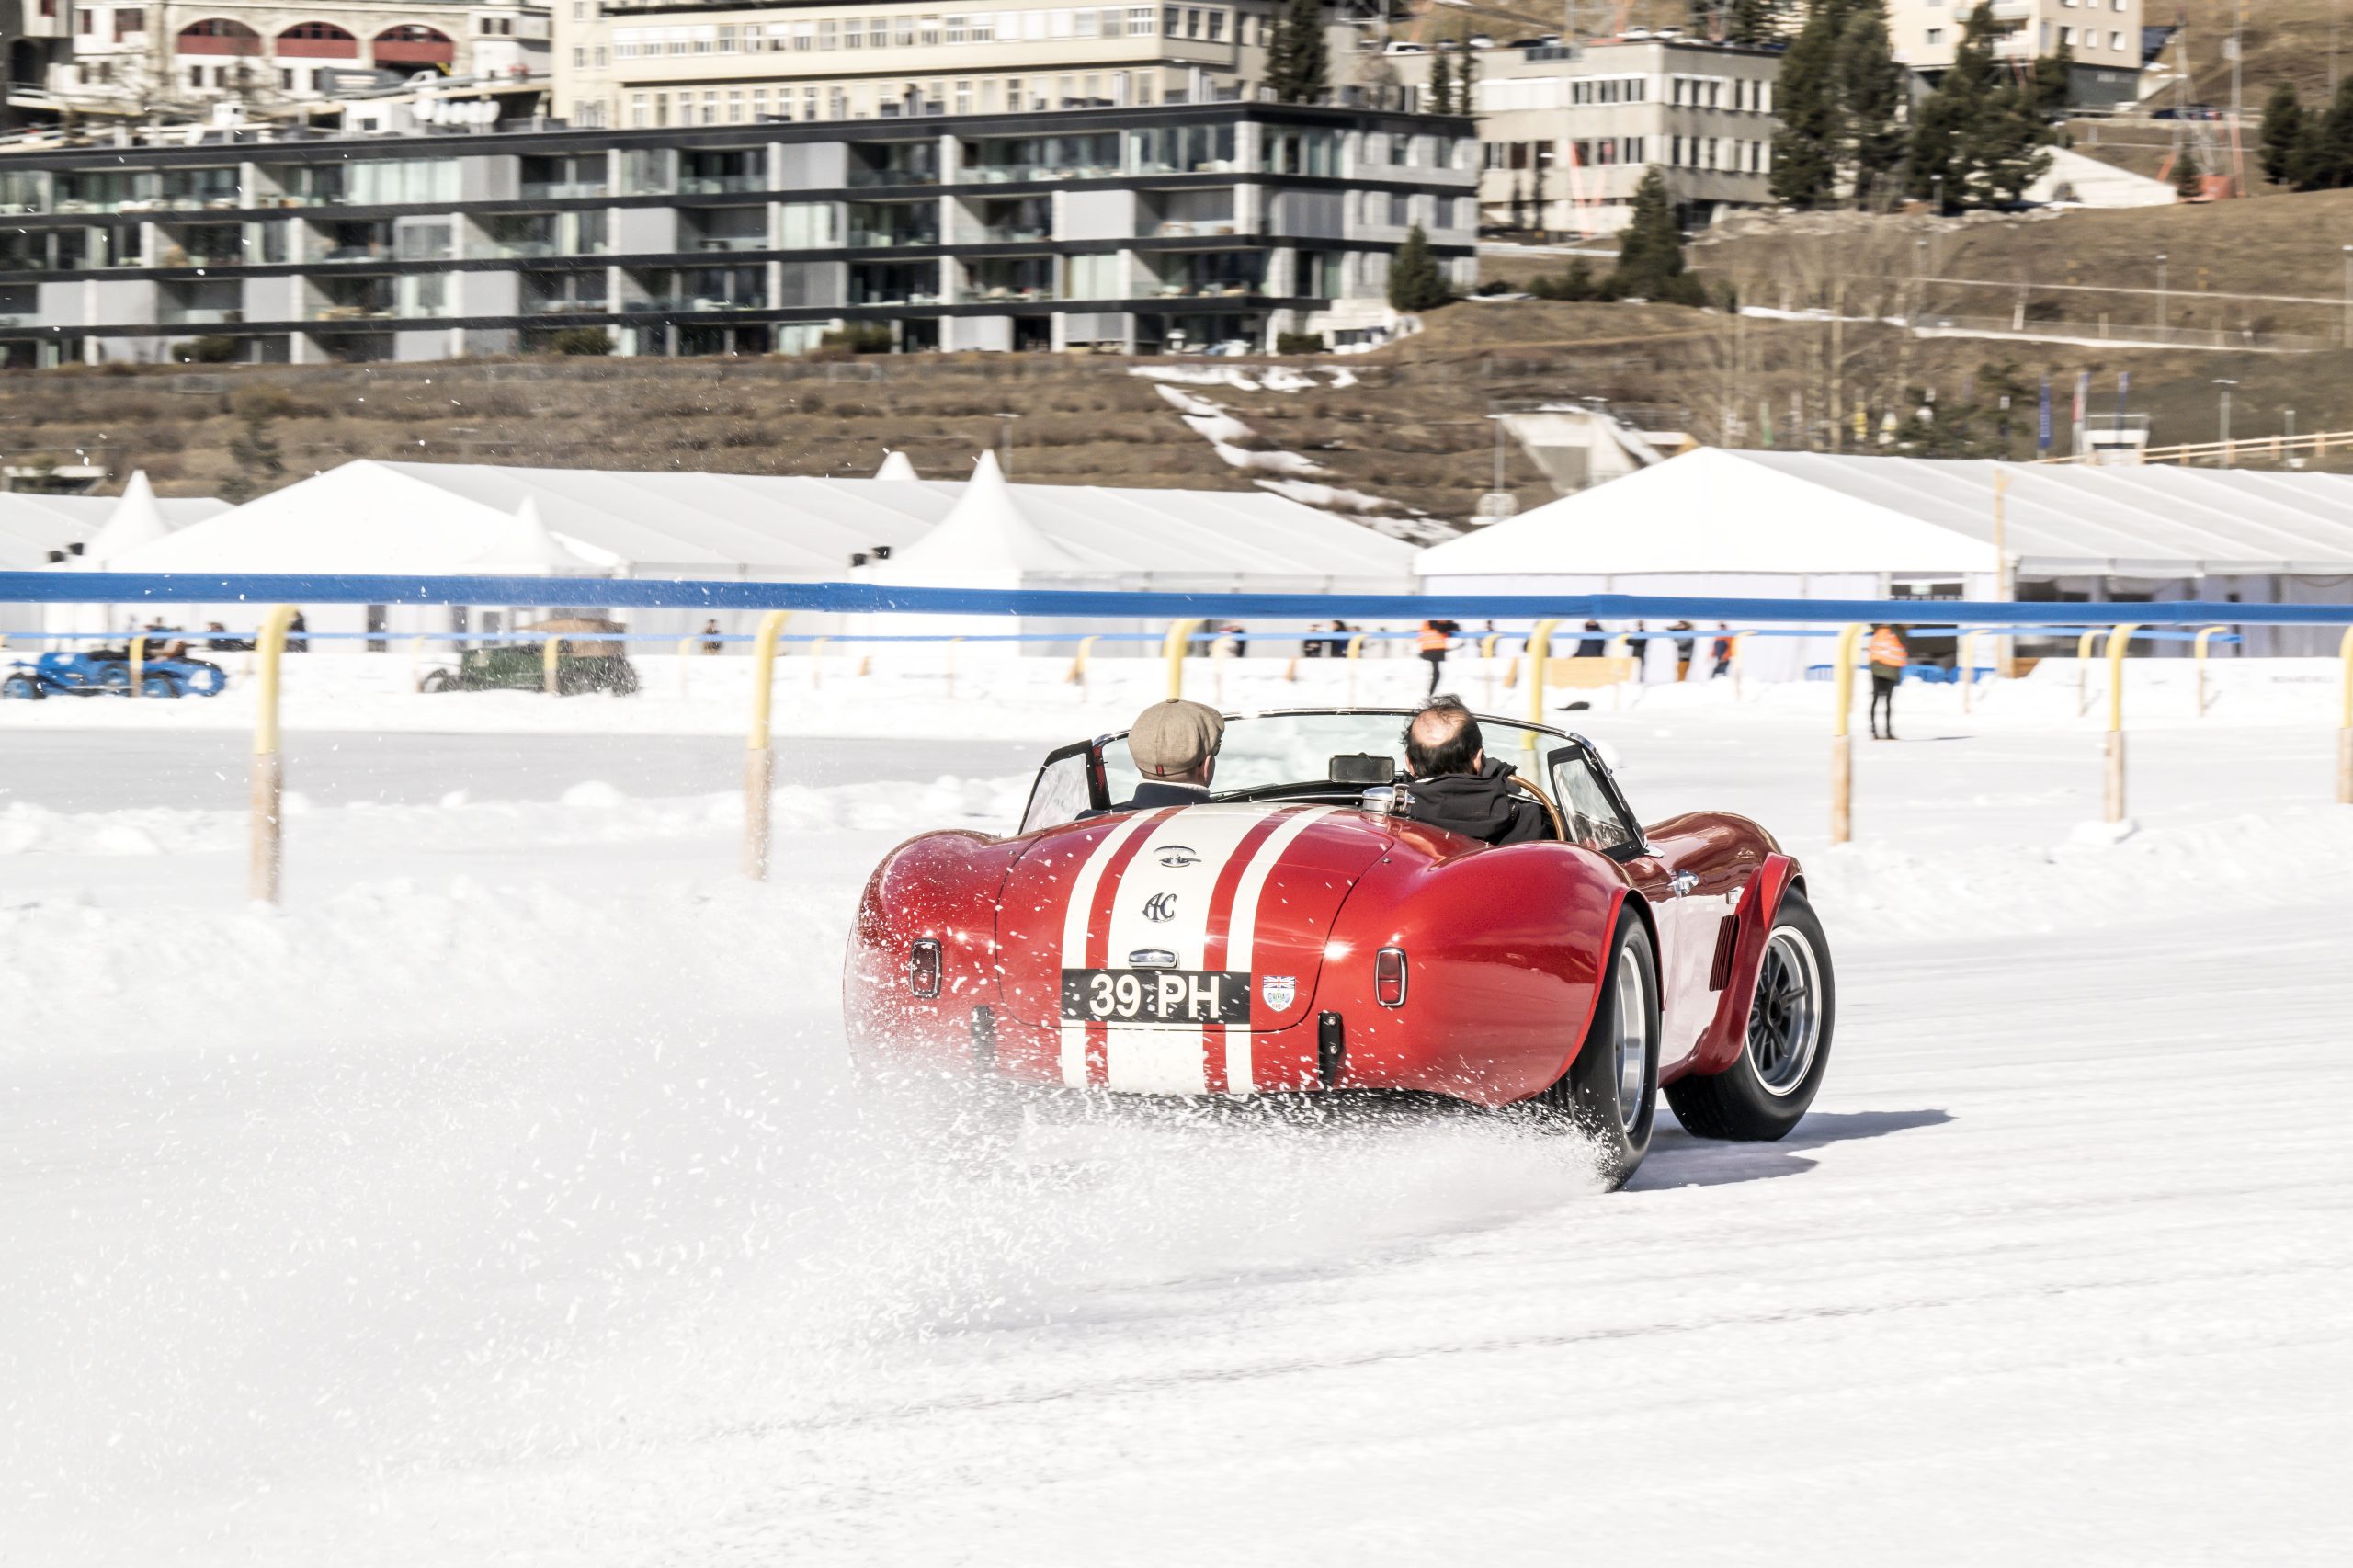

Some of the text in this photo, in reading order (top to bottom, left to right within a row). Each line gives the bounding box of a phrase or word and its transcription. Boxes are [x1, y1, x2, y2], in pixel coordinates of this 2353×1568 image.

[1142, 892, 1177, 921] AC
[1089, 973, 1220, 1018] 39 PH
